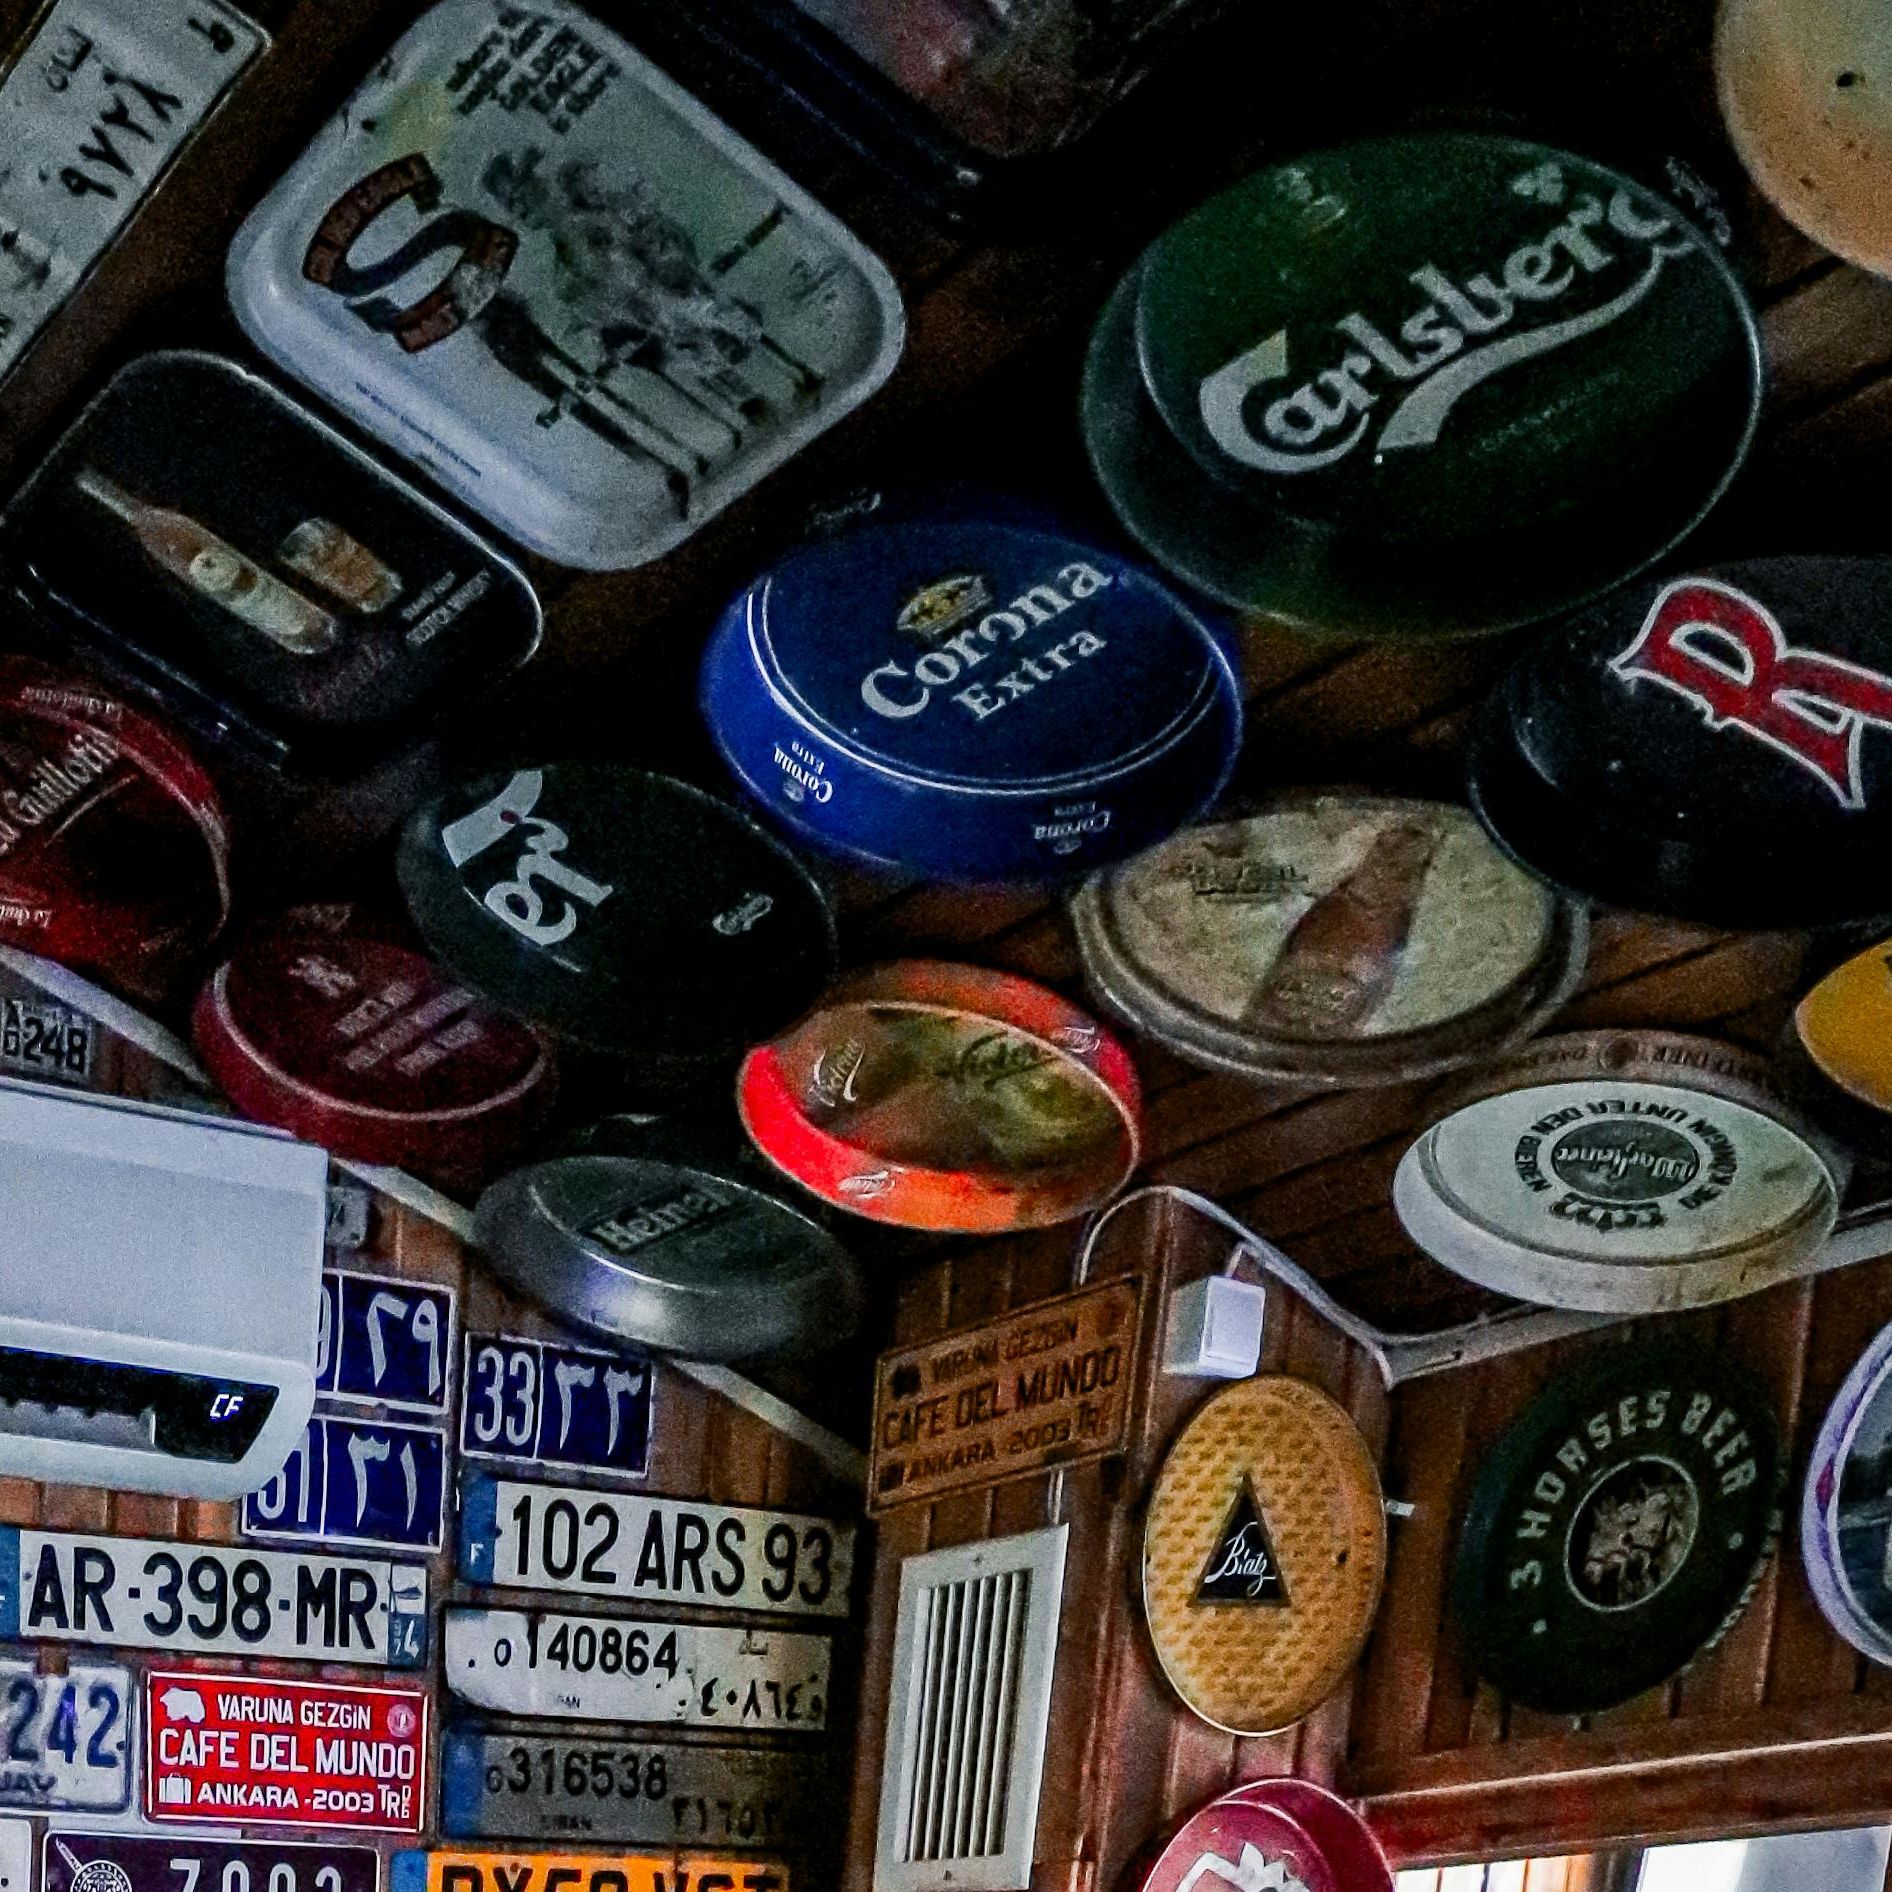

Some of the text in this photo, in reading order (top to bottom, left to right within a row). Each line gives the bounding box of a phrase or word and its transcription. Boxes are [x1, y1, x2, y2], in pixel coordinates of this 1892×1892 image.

[1198, 180, 1703, 476] Carlsberg
[860, 560, 1112, 720] Corona
[951, 627, 1108, 722] Extra
[1586, 1101, 1687, 1122] UNTER
[474, 1345, 536, 1445] 33
[879, 1345, 1121, 1453] CAFE DEL MUNDO
[1511, 1390, 1758, 1589] 3 HORSES BEER
[470, 1495, 832, 1602] F 102 ARS 93
[1205, 1521, 1277, 1595] Blatz
[6, 1676, 120, 1770] 242
[159, 1728, 416, 1781] CAFE DEL MUNDO
[217, 1693, 294, 1726] VARUNA
[196, 1781, 299, 1810] ANKARA
[508, 1749, 668, 1799] 316538
